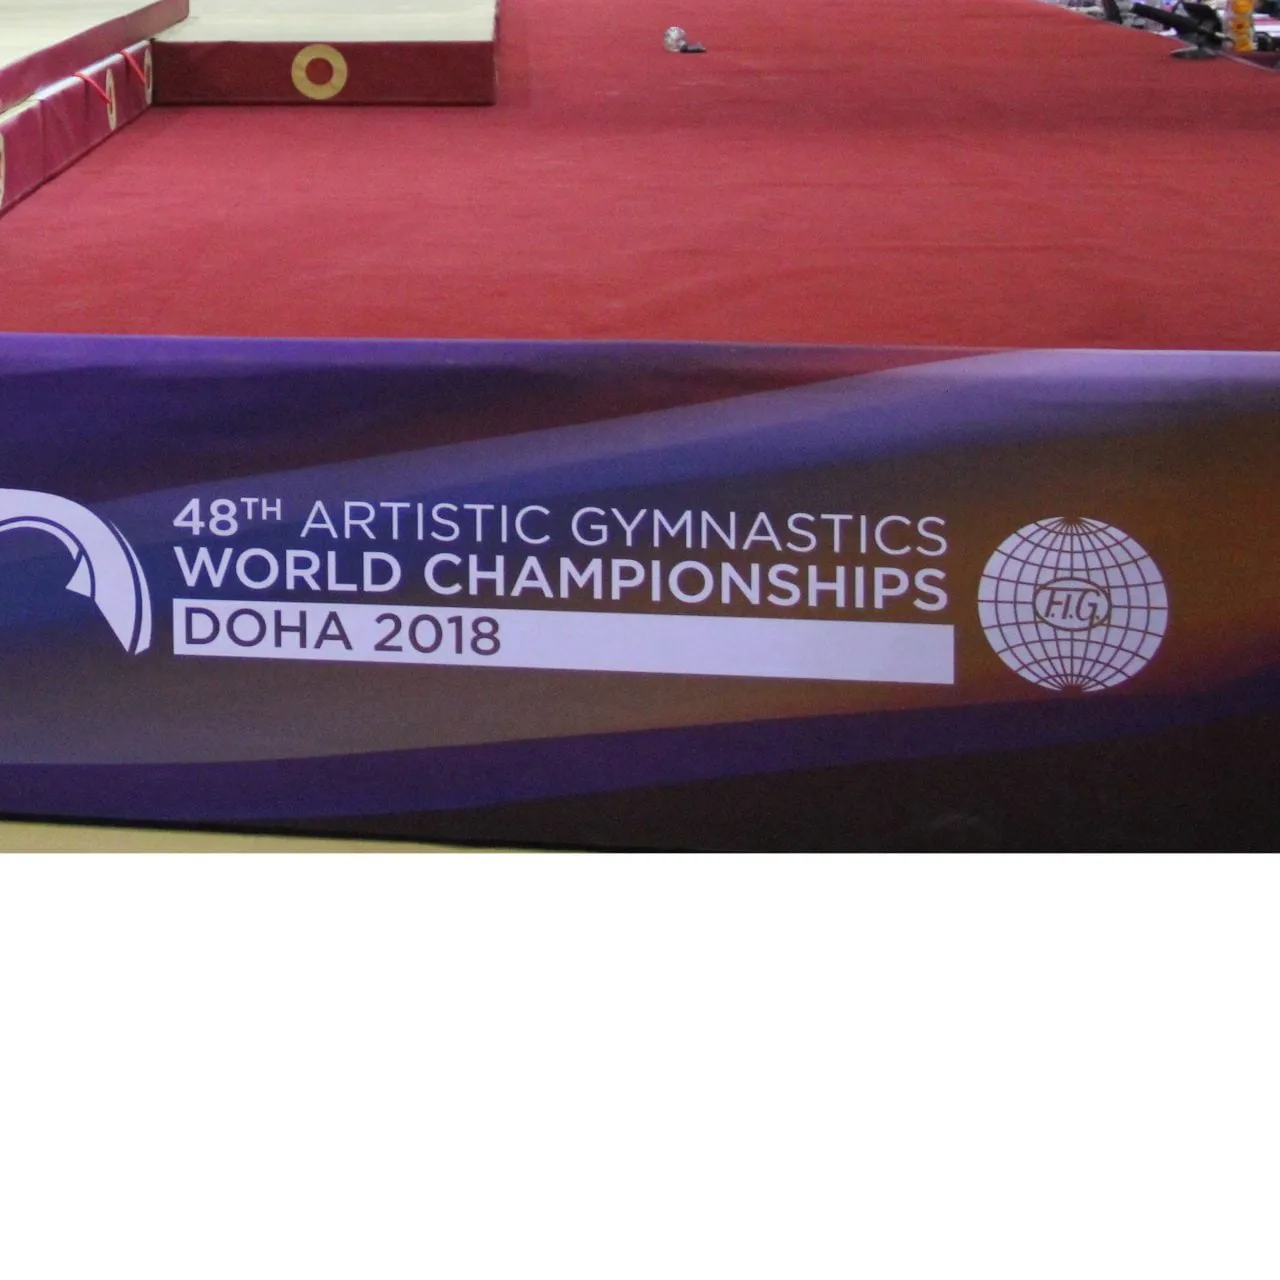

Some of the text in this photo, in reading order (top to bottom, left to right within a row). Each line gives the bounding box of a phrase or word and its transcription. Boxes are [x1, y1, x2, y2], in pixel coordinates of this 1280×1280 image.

[300, 499, 551, 545] ARTISTIC
[570, 505, 949, 558] GYMNASTICS
[172, 545, 949, 613] WORLD CHAMPIONSHIPS
[184, 606, 502, 657] DOHA 2018
